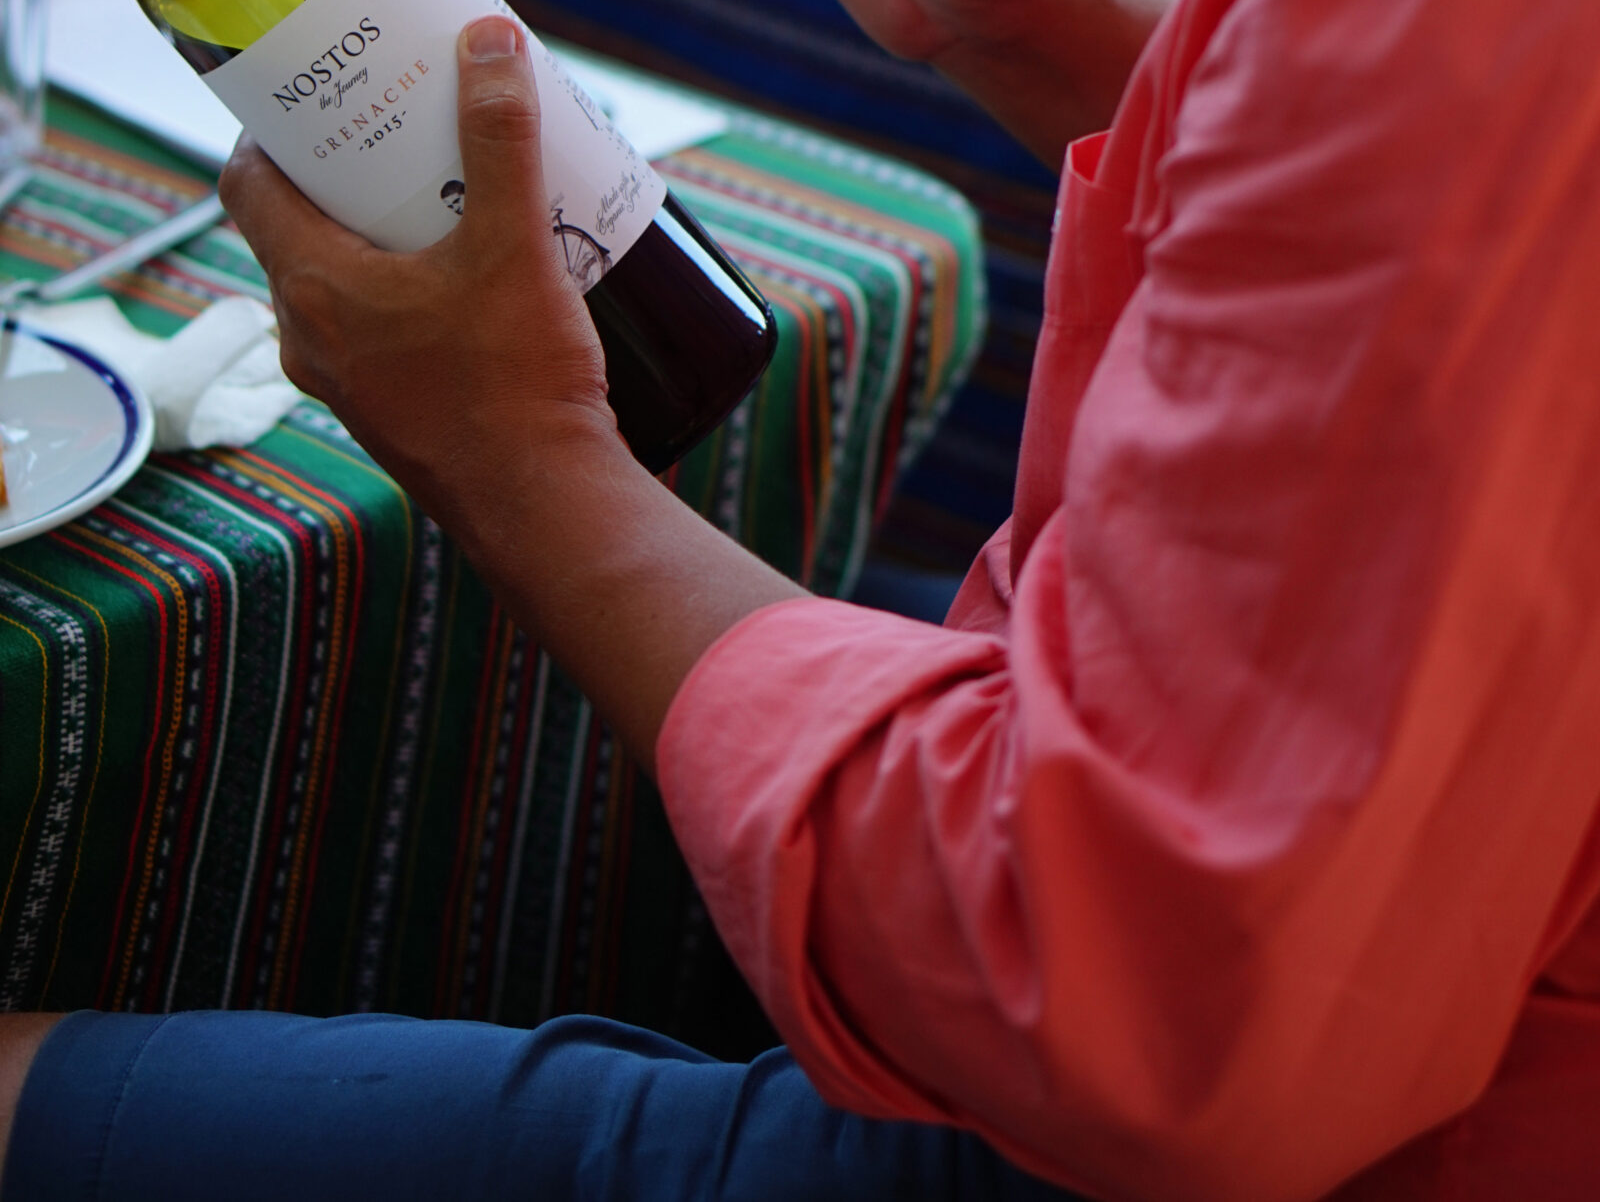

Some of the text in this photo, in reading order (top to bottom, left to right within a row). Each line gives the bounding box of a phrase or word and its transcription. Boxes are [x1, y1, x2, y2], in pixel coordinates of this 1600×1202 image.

[272, 16, 381, 112] NOSTOS
[313, 59, 429, 159] GRENACHE
[319, 66, 368, 111] the Journey
